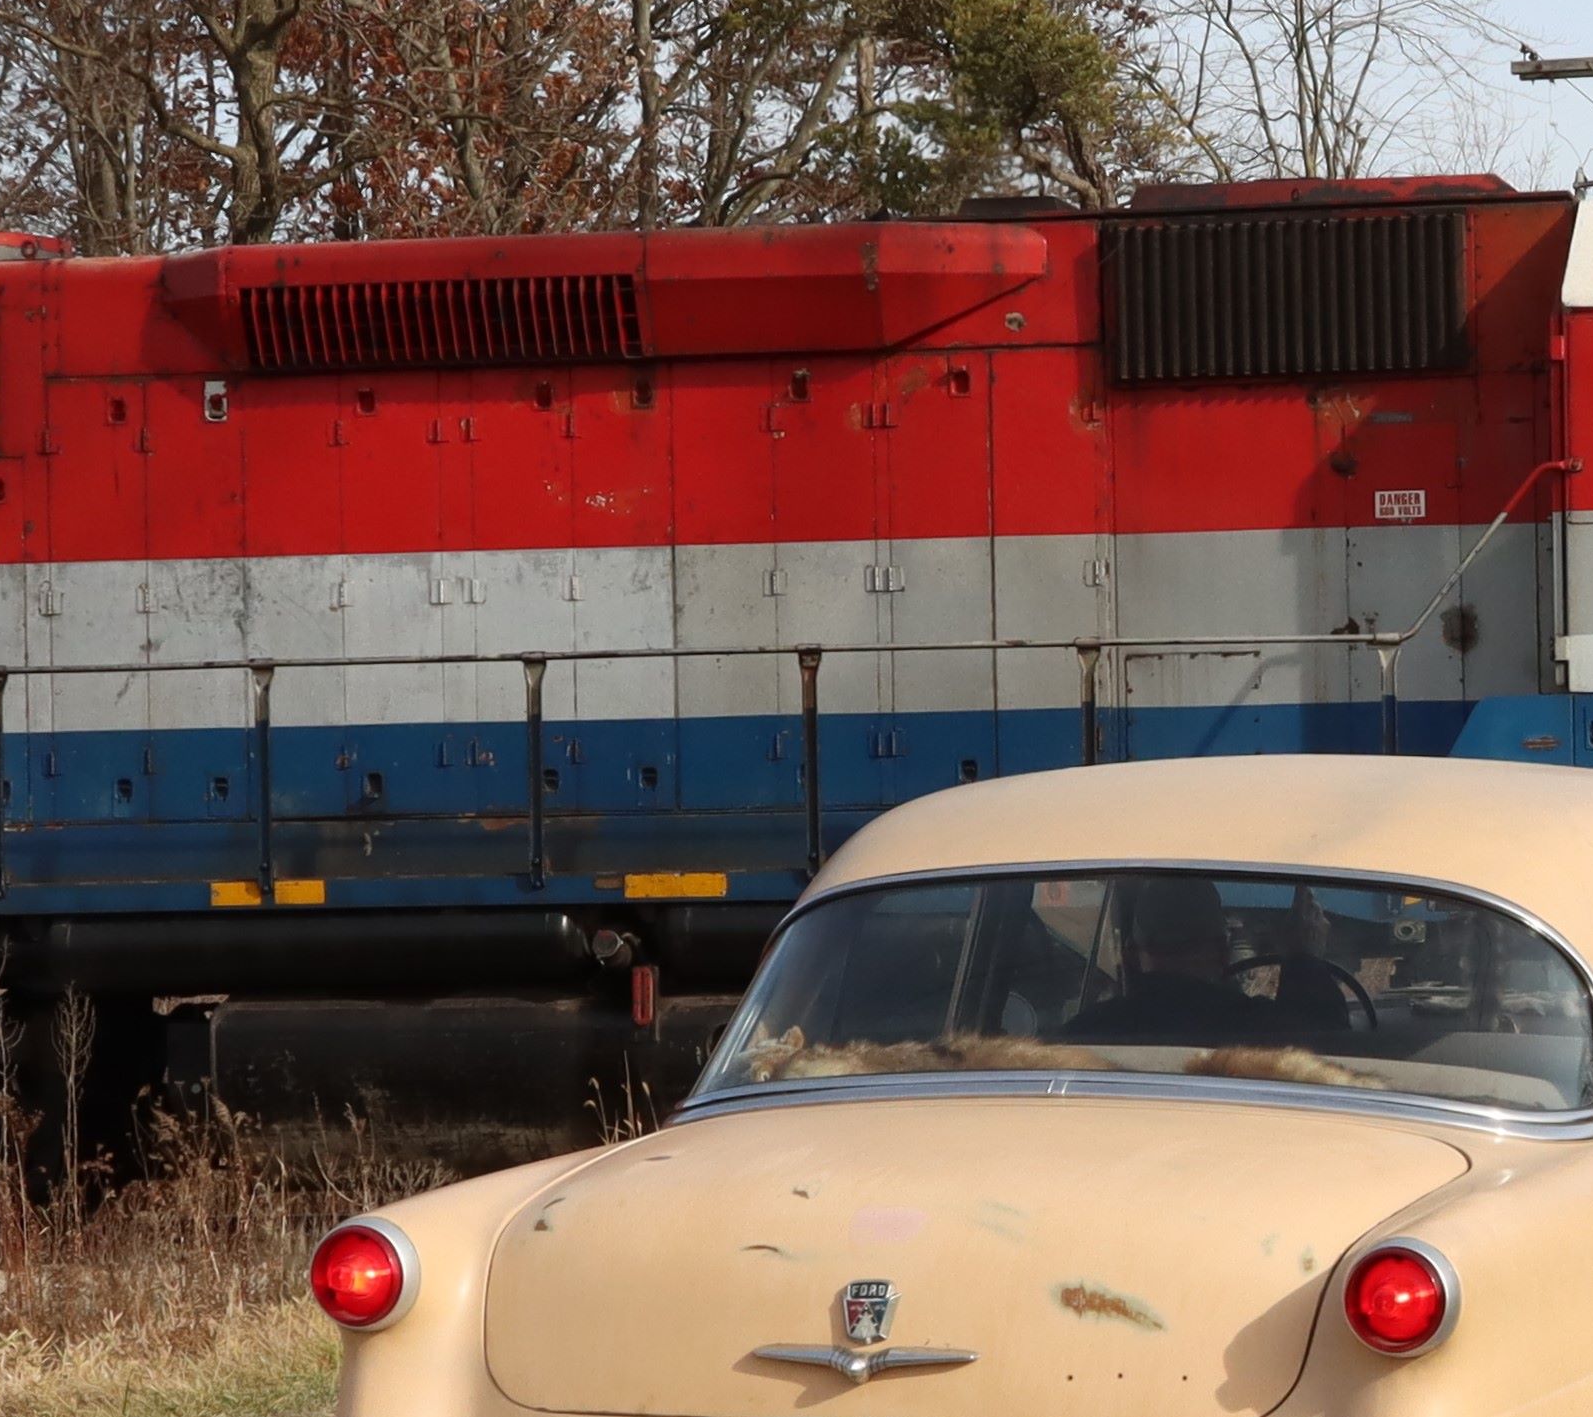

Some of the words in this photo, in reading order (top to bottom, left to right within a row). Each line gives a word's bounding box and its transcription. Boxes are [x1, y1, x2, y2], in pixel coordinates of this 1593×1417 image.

[1379, 492, 1421, 505] DANGER
[1398, 505, 1421, 516] VOLTS
[851, 1284, 886, 1297] FORD
